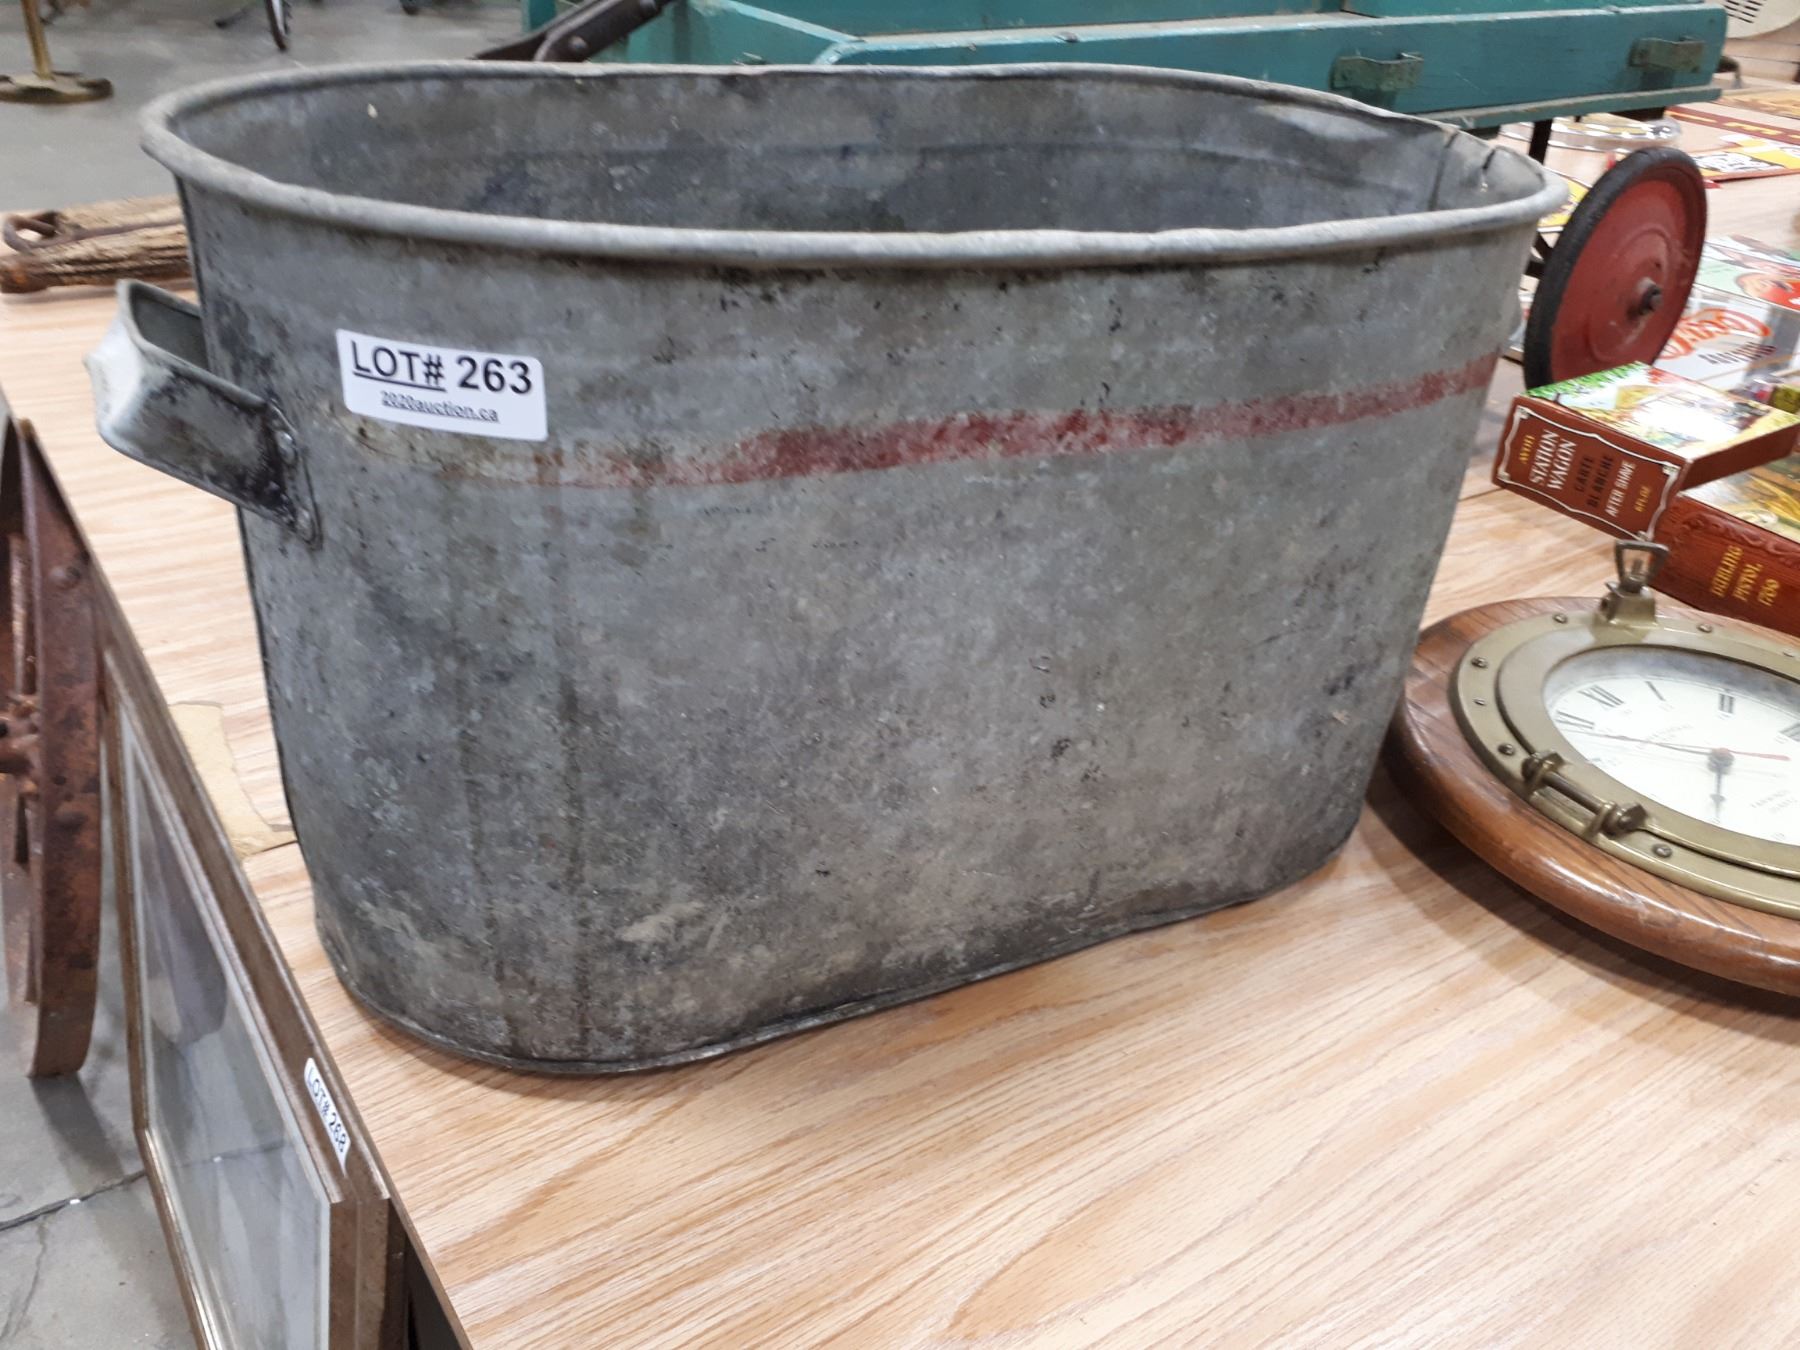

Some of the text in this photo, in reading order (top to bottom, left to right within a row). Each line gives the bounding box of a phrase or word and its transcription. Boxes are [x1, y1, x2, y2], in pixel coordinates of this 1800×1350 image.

[351, 340, 533, 395] LOT# 263
[381, 390, 500, 424] 2020auction.ca
[1528, 428, 1560, 486] STATION
[1546, 437, 1577, 491] WAGON
[1604, 459, 1637, 518] AFTER SHAVE
